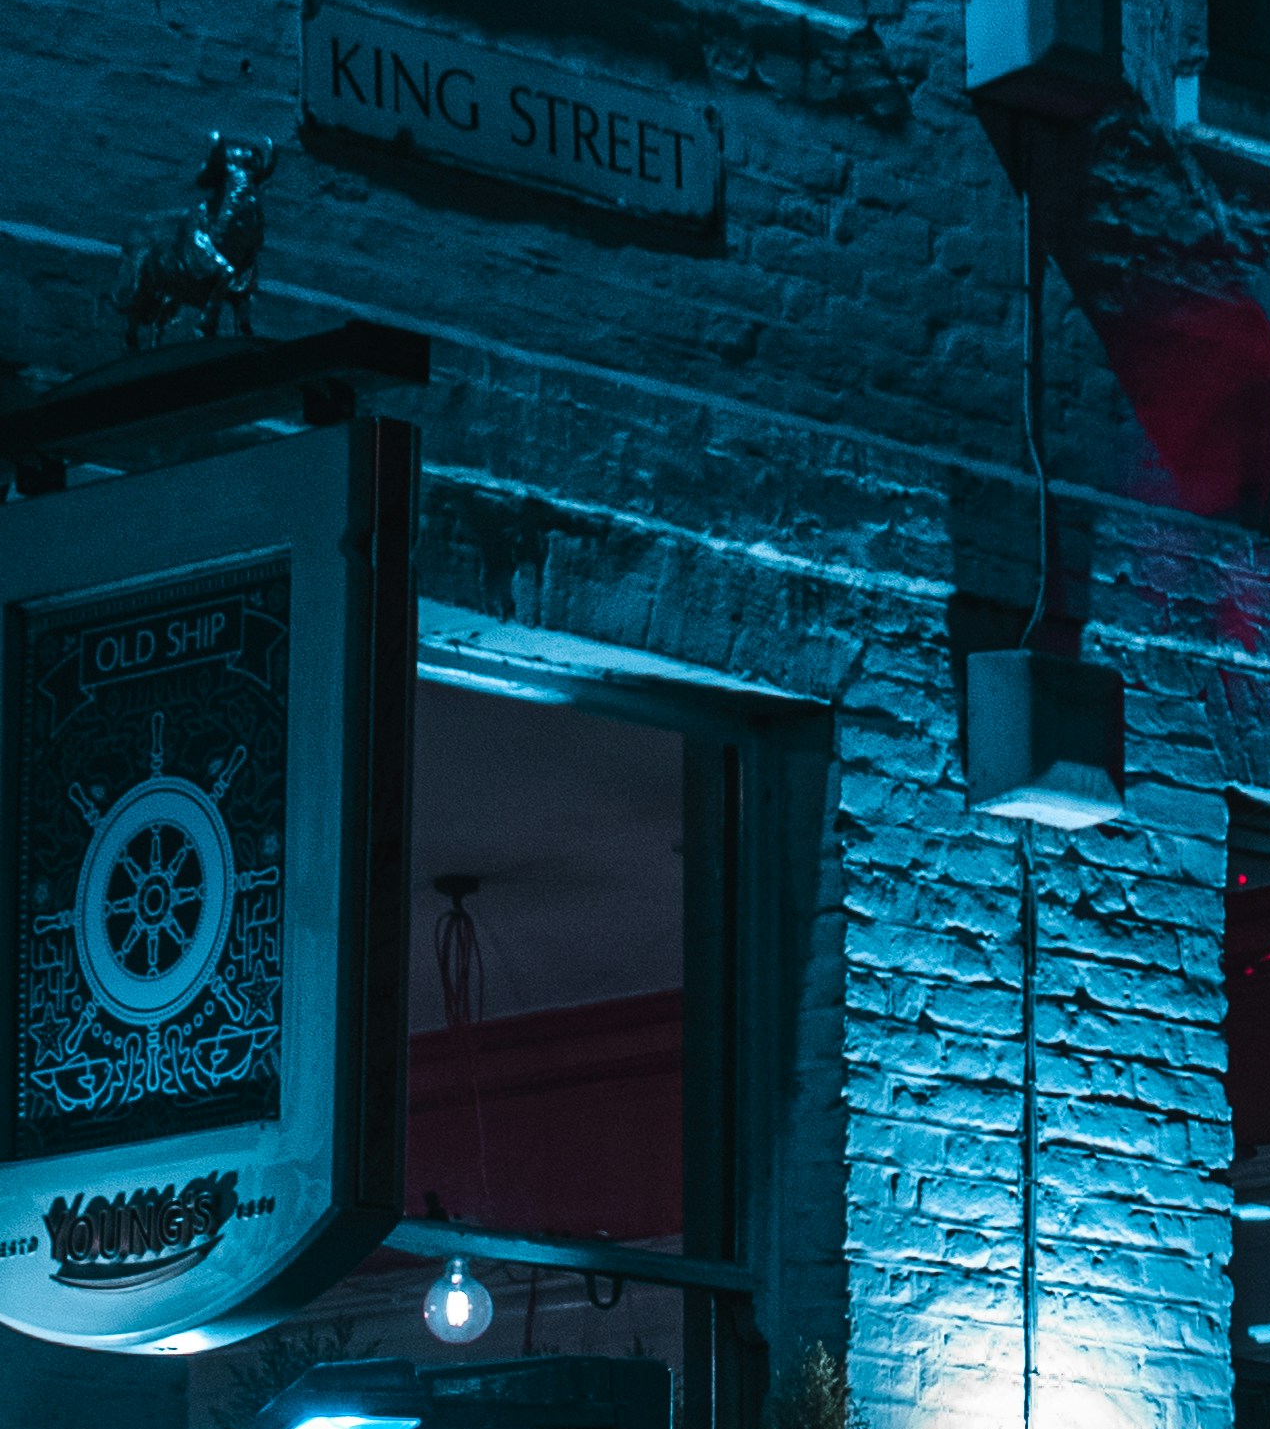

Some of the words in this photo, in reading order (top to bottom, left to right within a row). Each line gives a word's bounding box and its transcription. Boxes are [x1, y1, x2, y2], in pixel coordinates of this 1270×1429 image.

[330, 36, 480, 132] KING
[509, 84, 695, 190] STREET
[96, 629, 155, 671] OLD
[166, 611, 226, 657] SHIP
[43, 1178, 222, 1264] YOUNG'S
